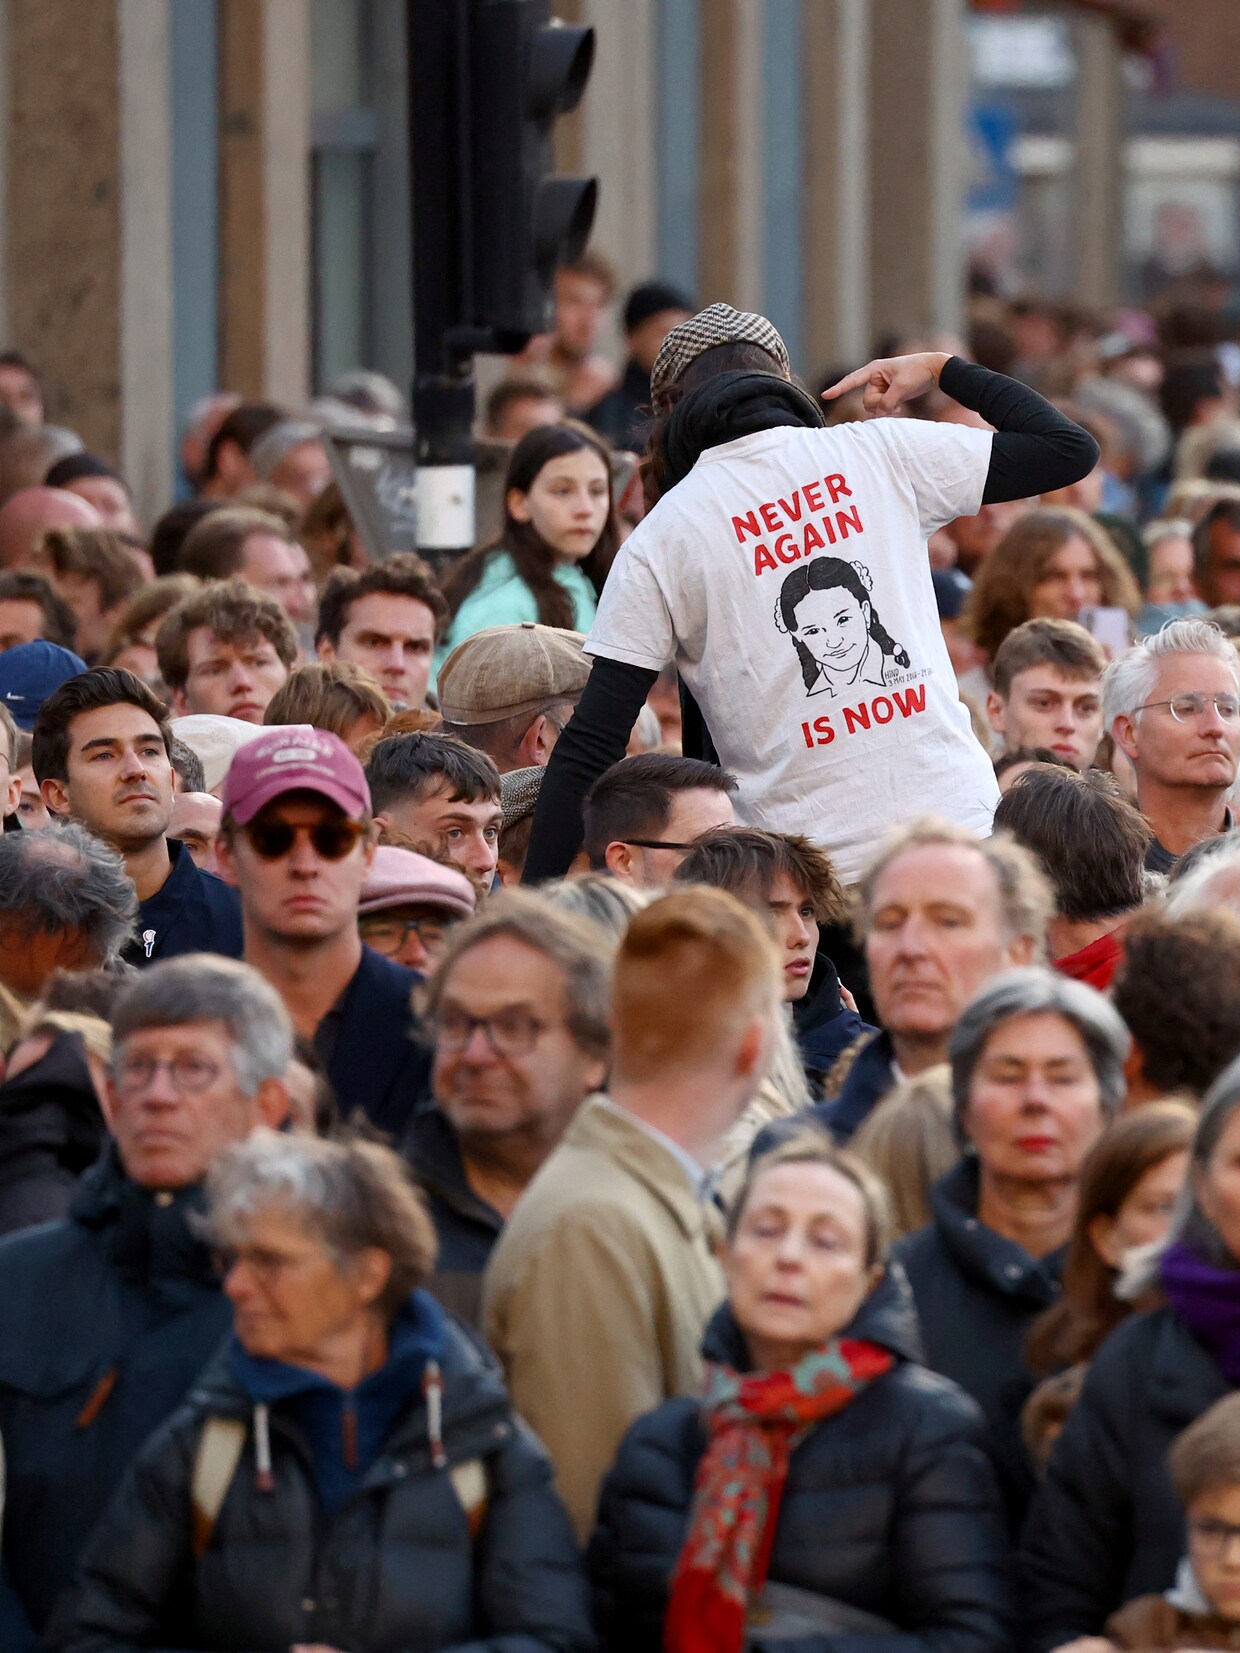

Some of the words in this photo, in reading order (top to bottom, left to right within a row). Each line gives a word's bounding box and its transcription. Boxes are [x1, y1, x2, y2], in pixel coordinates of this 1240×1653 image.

[731, 473, 852, 543] NEVER
[754, 505, 863, 576] AGAIN
[888, 679, 894, 687] 3
[894, 675, 905, 685] MAY
[801, 716, 835, 748] IS
[842, 684, 926, 734] NOW
